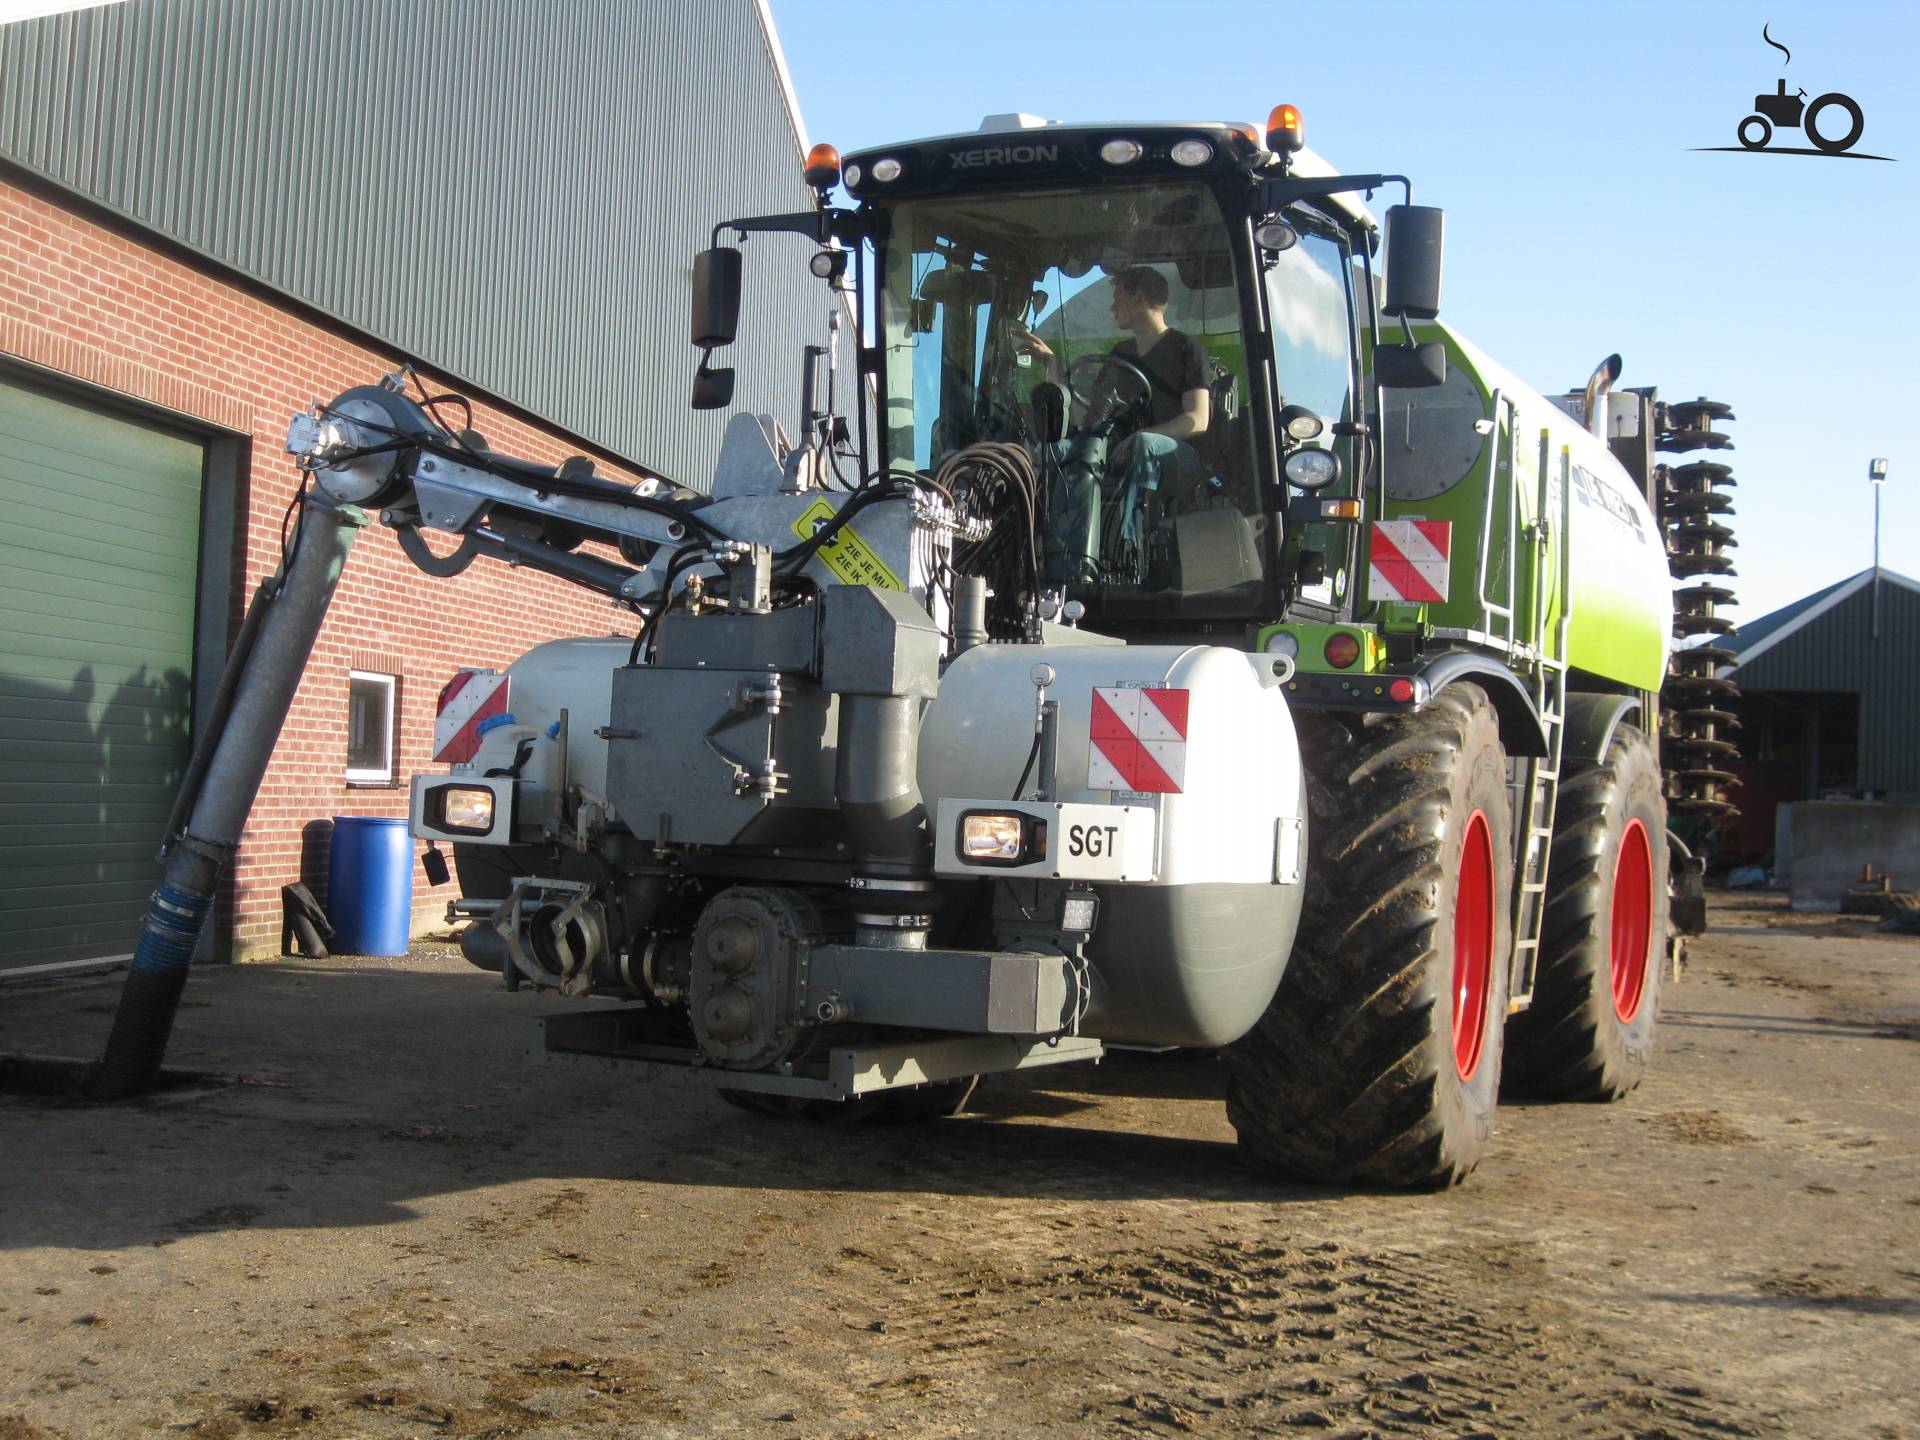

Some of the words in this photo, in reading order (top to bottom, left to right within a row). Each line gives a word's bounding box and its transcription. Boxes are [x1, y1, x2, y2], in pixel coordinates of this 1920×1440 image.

[949, 145, 1057, 169] XERION
[835, 553, 853, 572] ZIE
[851, 569, 863, 583] IK
[844, 542, 862, 561] ZIE
[860, 561, 874, 574] JE
[1068, 824, 1118, 858] SGT
